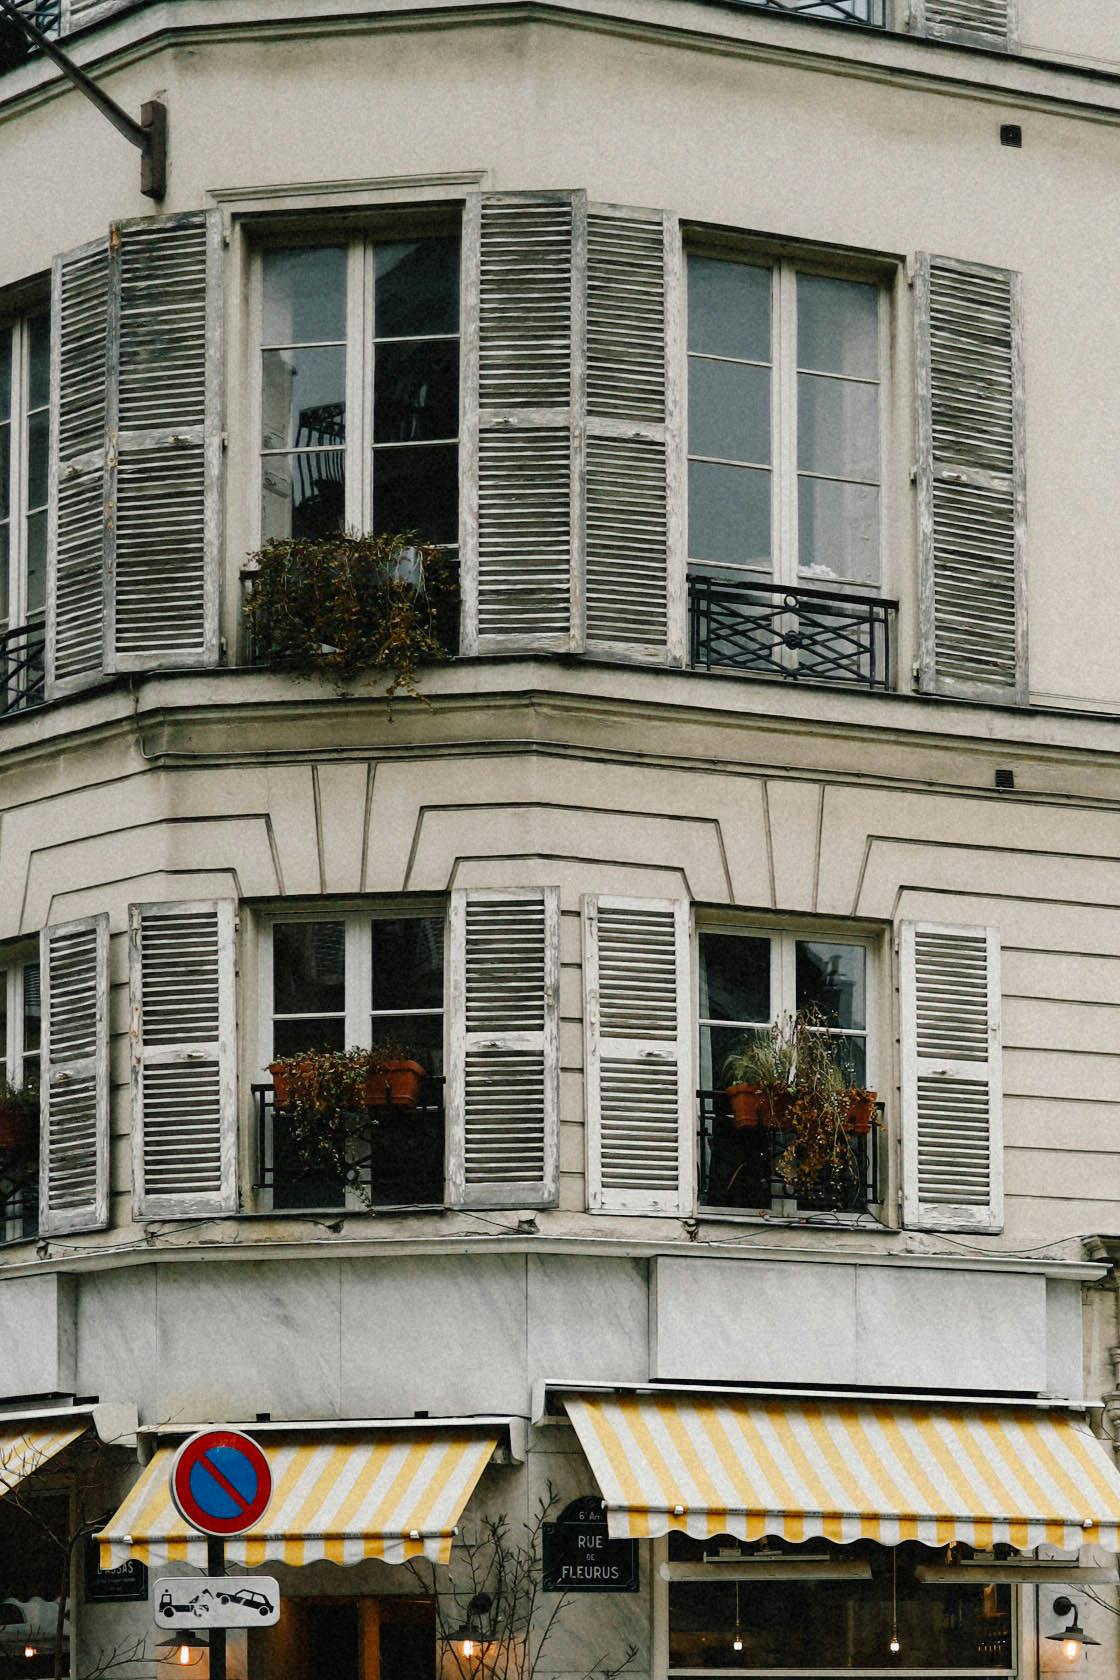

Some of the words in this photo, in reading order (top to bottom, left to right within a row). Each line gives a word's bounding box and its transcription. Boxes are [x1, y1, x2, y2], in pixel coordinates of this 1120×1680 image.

[578, 1535, 604, 1549] RUE
[586, 1553, 596, 1561] DE
[562, 1566, 619, 1579] FLEURUS
